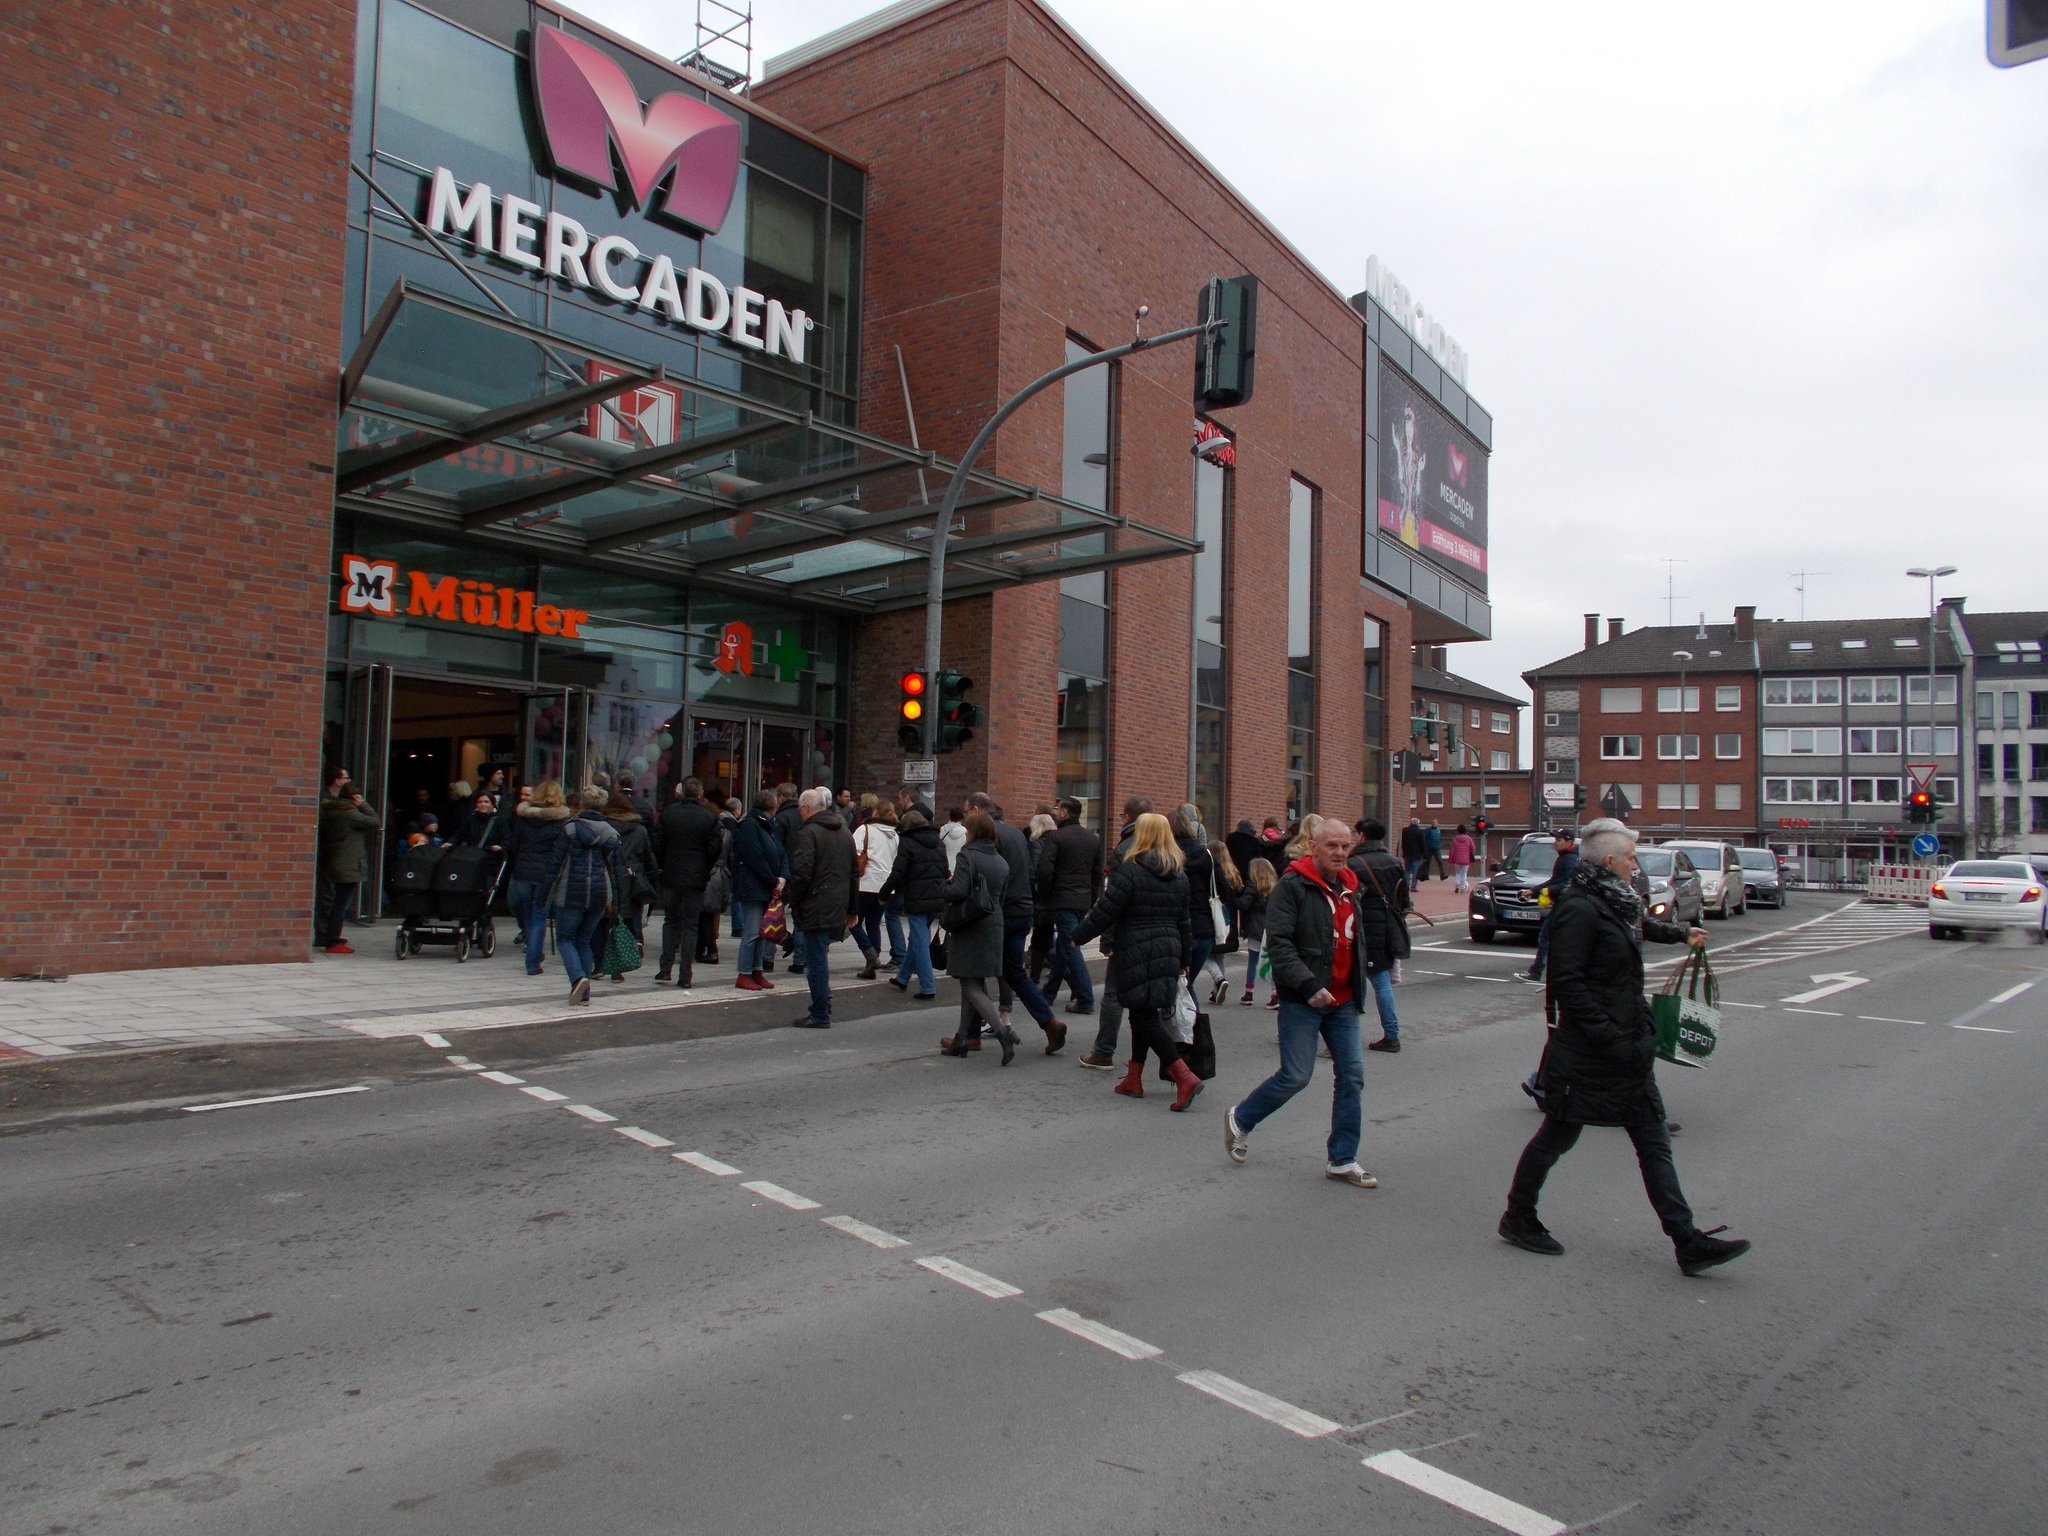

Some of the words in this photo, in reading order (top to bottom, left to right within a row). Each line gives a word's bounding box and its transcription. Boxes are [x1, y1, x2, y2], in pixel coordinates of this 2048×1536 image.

[427, 166, 806, 363] MERCADEN
[1440, 482, 1474, 520] MERCADEN
[407, 570, 589, 638] Müller
[1680, 1027, 1713, 1047] DEPOT
